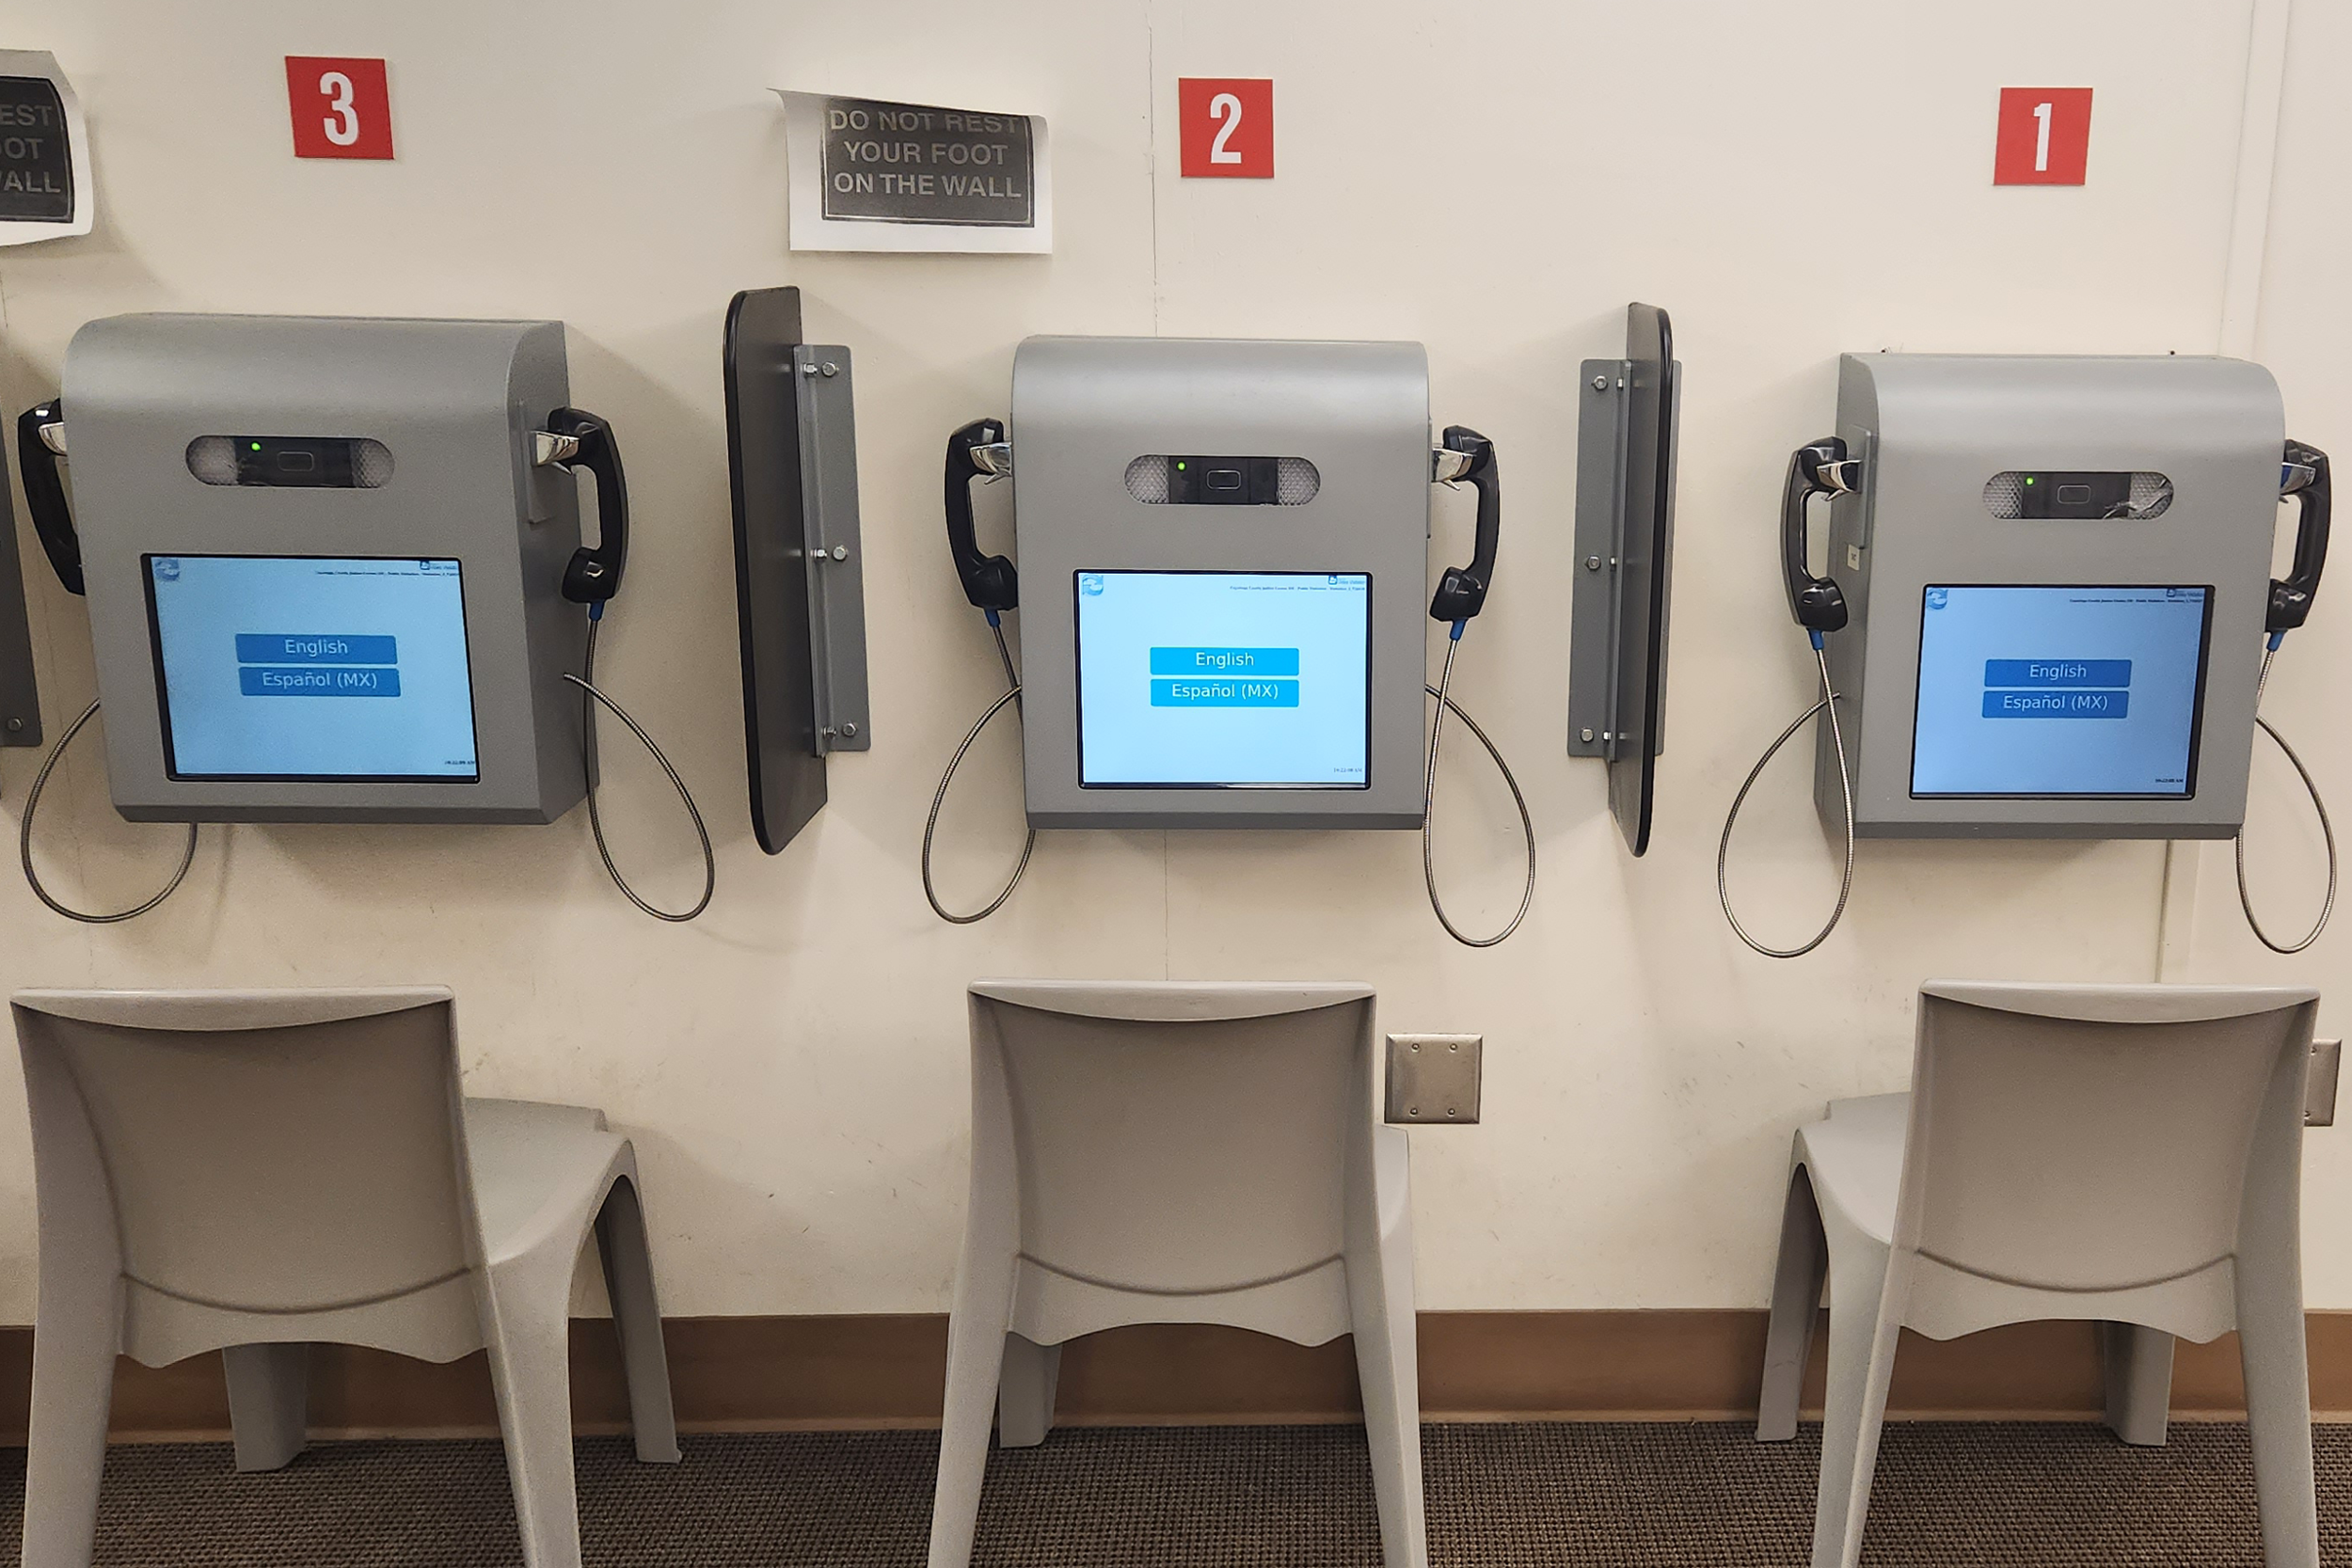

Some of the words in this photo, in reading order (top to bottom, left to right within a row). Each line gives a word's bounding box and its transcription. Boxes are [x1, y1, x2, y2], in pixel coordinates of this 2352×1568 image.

[319, 71, 359, 146] 3
[829, 109, 870, 131] DO
[877, 111, 935, 132] NOT
[945, 113, 1019, 135] REST
[1210, 92, 1242, 164] 2
[0, 136, 44, 160] OT
[2033, 103, 2053, 171] 1
[844, 141, 922, 164] YOUR
[930, 143, 1009, 166] FOOT
[0, 170, 61, 194] ALL
[834, 172, 874, 194] ON
[880, 173, 935, 196] THE
[941, 175, 1022, 198] WALL
[284, 639, 348, 657] English
[1195, 651, 1255, 670] English
[2029, 664, 2088, 681] English
[262, 672, 330, 689] Español
[337, 673, 377, 689] (MX)
[1171, 683, 1235, 701] Español
[1241, 683, 1279, 700] (MX)
[2003, 694, 2066, 712] Español
[2071, 695, 2108, 710] (MX)
